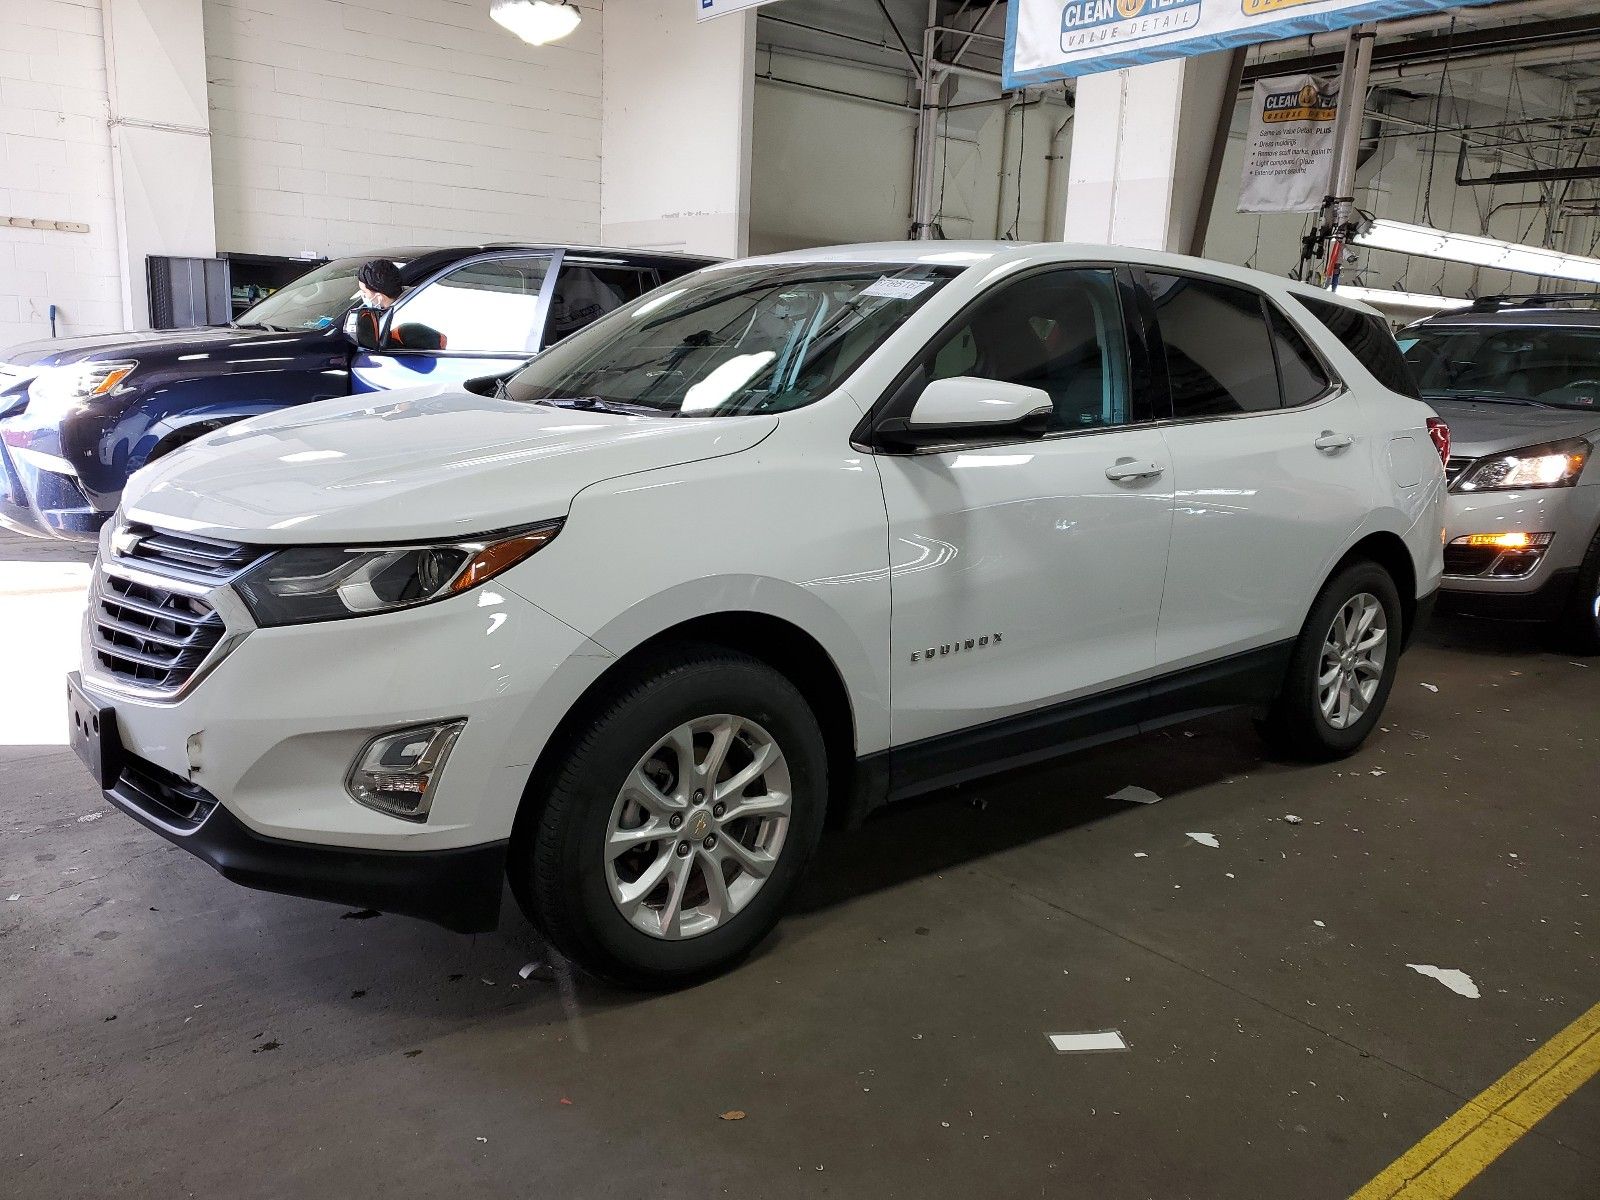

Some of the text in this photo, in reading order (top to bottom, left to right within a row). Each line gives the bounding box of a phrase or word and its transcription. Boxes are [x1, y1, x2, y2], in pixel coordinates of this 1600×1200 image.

[1065, 0, 1114, 27] CLEAN
[1068, 11, 1190, 46] VALUE DETAIL
[1266, 94, 1298, 109] CLEAN
[1283, 127, 1296, 135] Value
[1315, 127, 1332, 135] PLUS
[1259, 139, 1297, 148] Dress moldings
[1279, 148, 1292, 156] scuff
[1311, 148, 1326, 156] paint
[1255, 159, 1269, 168] Light
[1269, 159, 1295, 167] compound
[1254, 168, 1274, 176] Exterior
[911, 632, 1003, 662] EQUINOX
